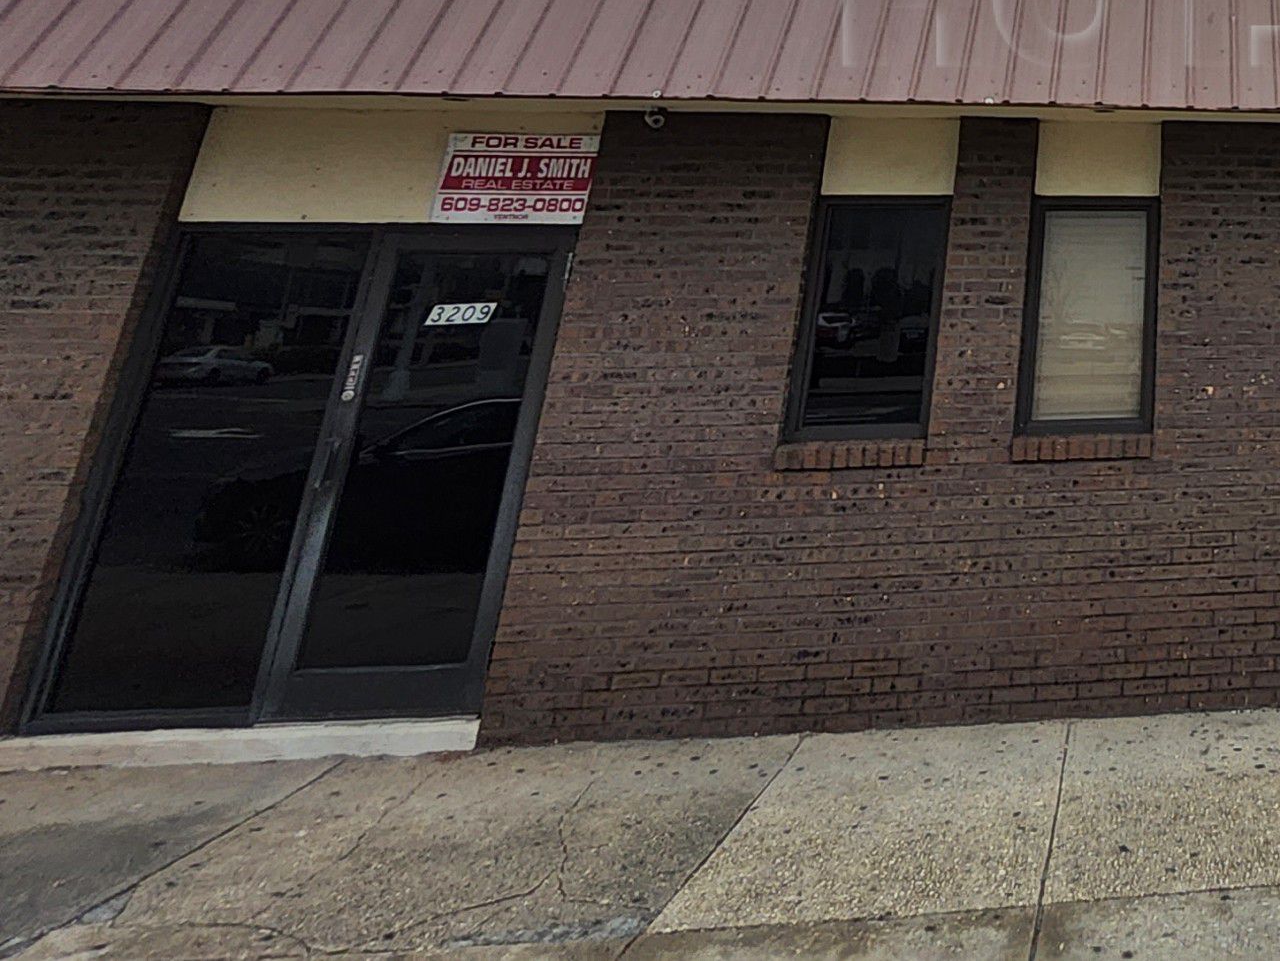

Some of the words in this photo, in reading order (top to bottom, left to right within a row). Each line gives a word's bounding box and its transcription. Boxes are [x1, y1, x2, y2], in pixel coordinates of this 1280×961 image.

[470, 136, 519, 149] FOR
[523, 137, 582, 149] SALE
[451, 157, 514, 177] DANIEL
[517, 158, 532, 178] J.
[537, 157, 591, 178] SMITH
[462, 179, 506, 190] REAL
[512, 180, 574, 190] ESTATE
[441, 197, 585, 212] 609-823-0800
[430, 304, 492, 323] 3209
